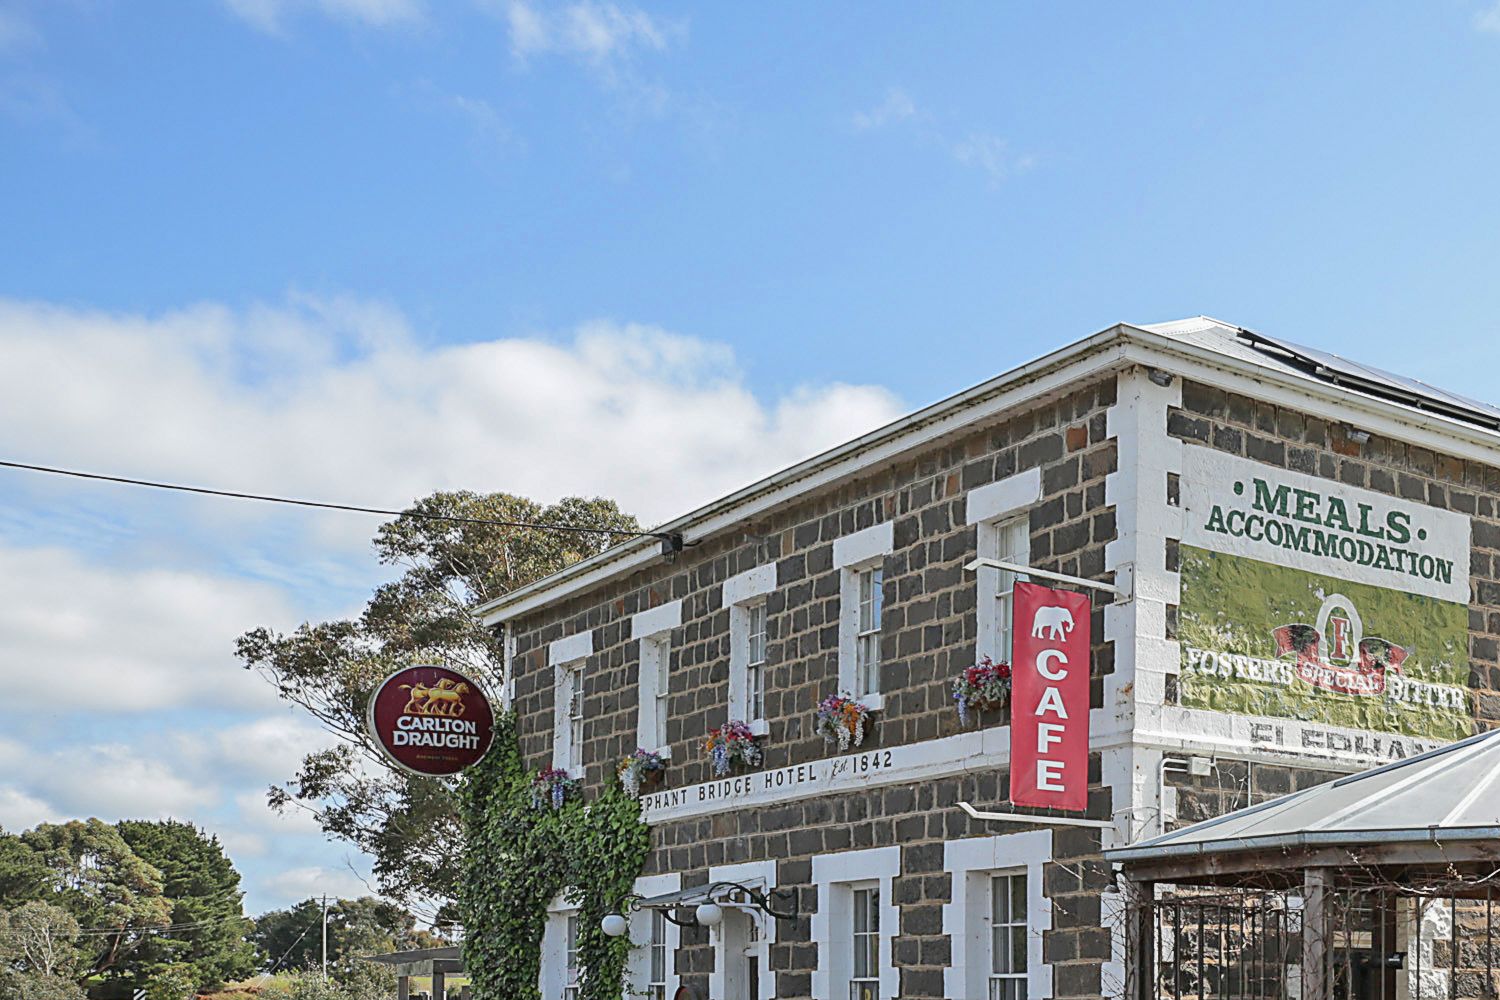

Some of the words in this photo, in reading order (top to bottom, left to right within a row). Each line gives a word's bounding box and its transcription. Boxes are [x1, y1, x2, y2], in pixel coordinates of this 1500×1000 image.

[1204, 505, 1453, 584] ACCOMMODATION
[1300, 663, 1379, 691] SPECIAL
[1388, 674, 1466, 710] BITTER
[393, 731, 480, 749] DRAUGHT
[396, 716, 476, 734] CARLTON
[1035, 649, 1068, 792] CAFE
[638, 789, 687, 812] EPHANT
[699, 776, 751, 801] BRIDGE
[765, 765, 816, 789] HOTEL
[853, 751, 892, 773] 1842
